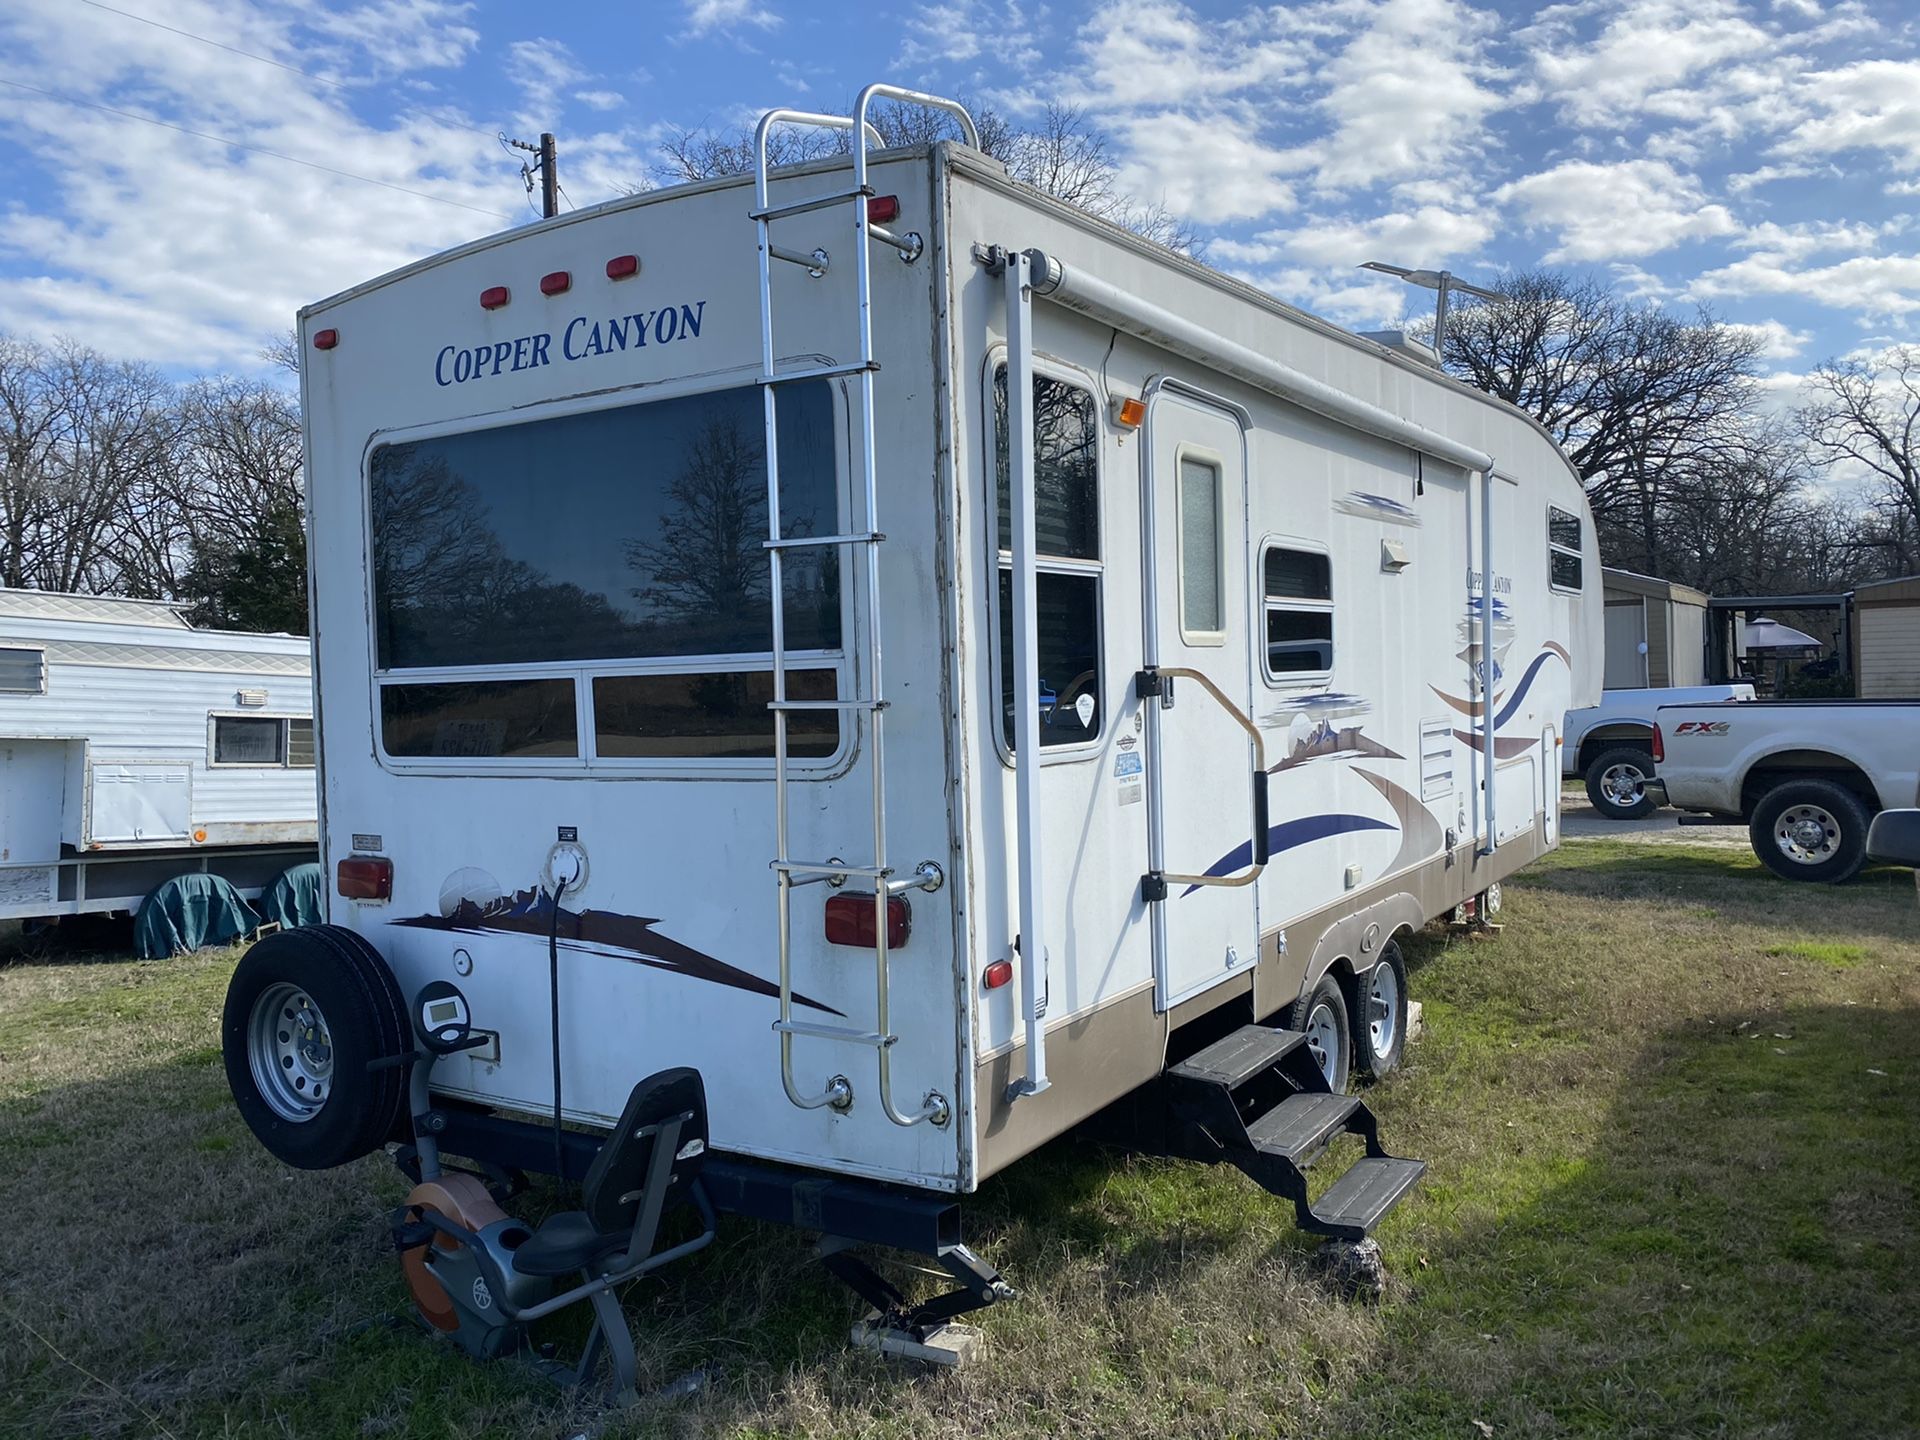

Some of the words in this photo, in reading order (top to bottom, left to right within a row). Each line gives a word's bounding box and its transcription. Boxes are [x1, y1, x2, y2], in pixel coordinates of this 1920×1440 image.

[435, 333, 551, 387] COPPER
[562, 301, 706, 361] CANYON
[1674, 721, 1731, 732] FX4
